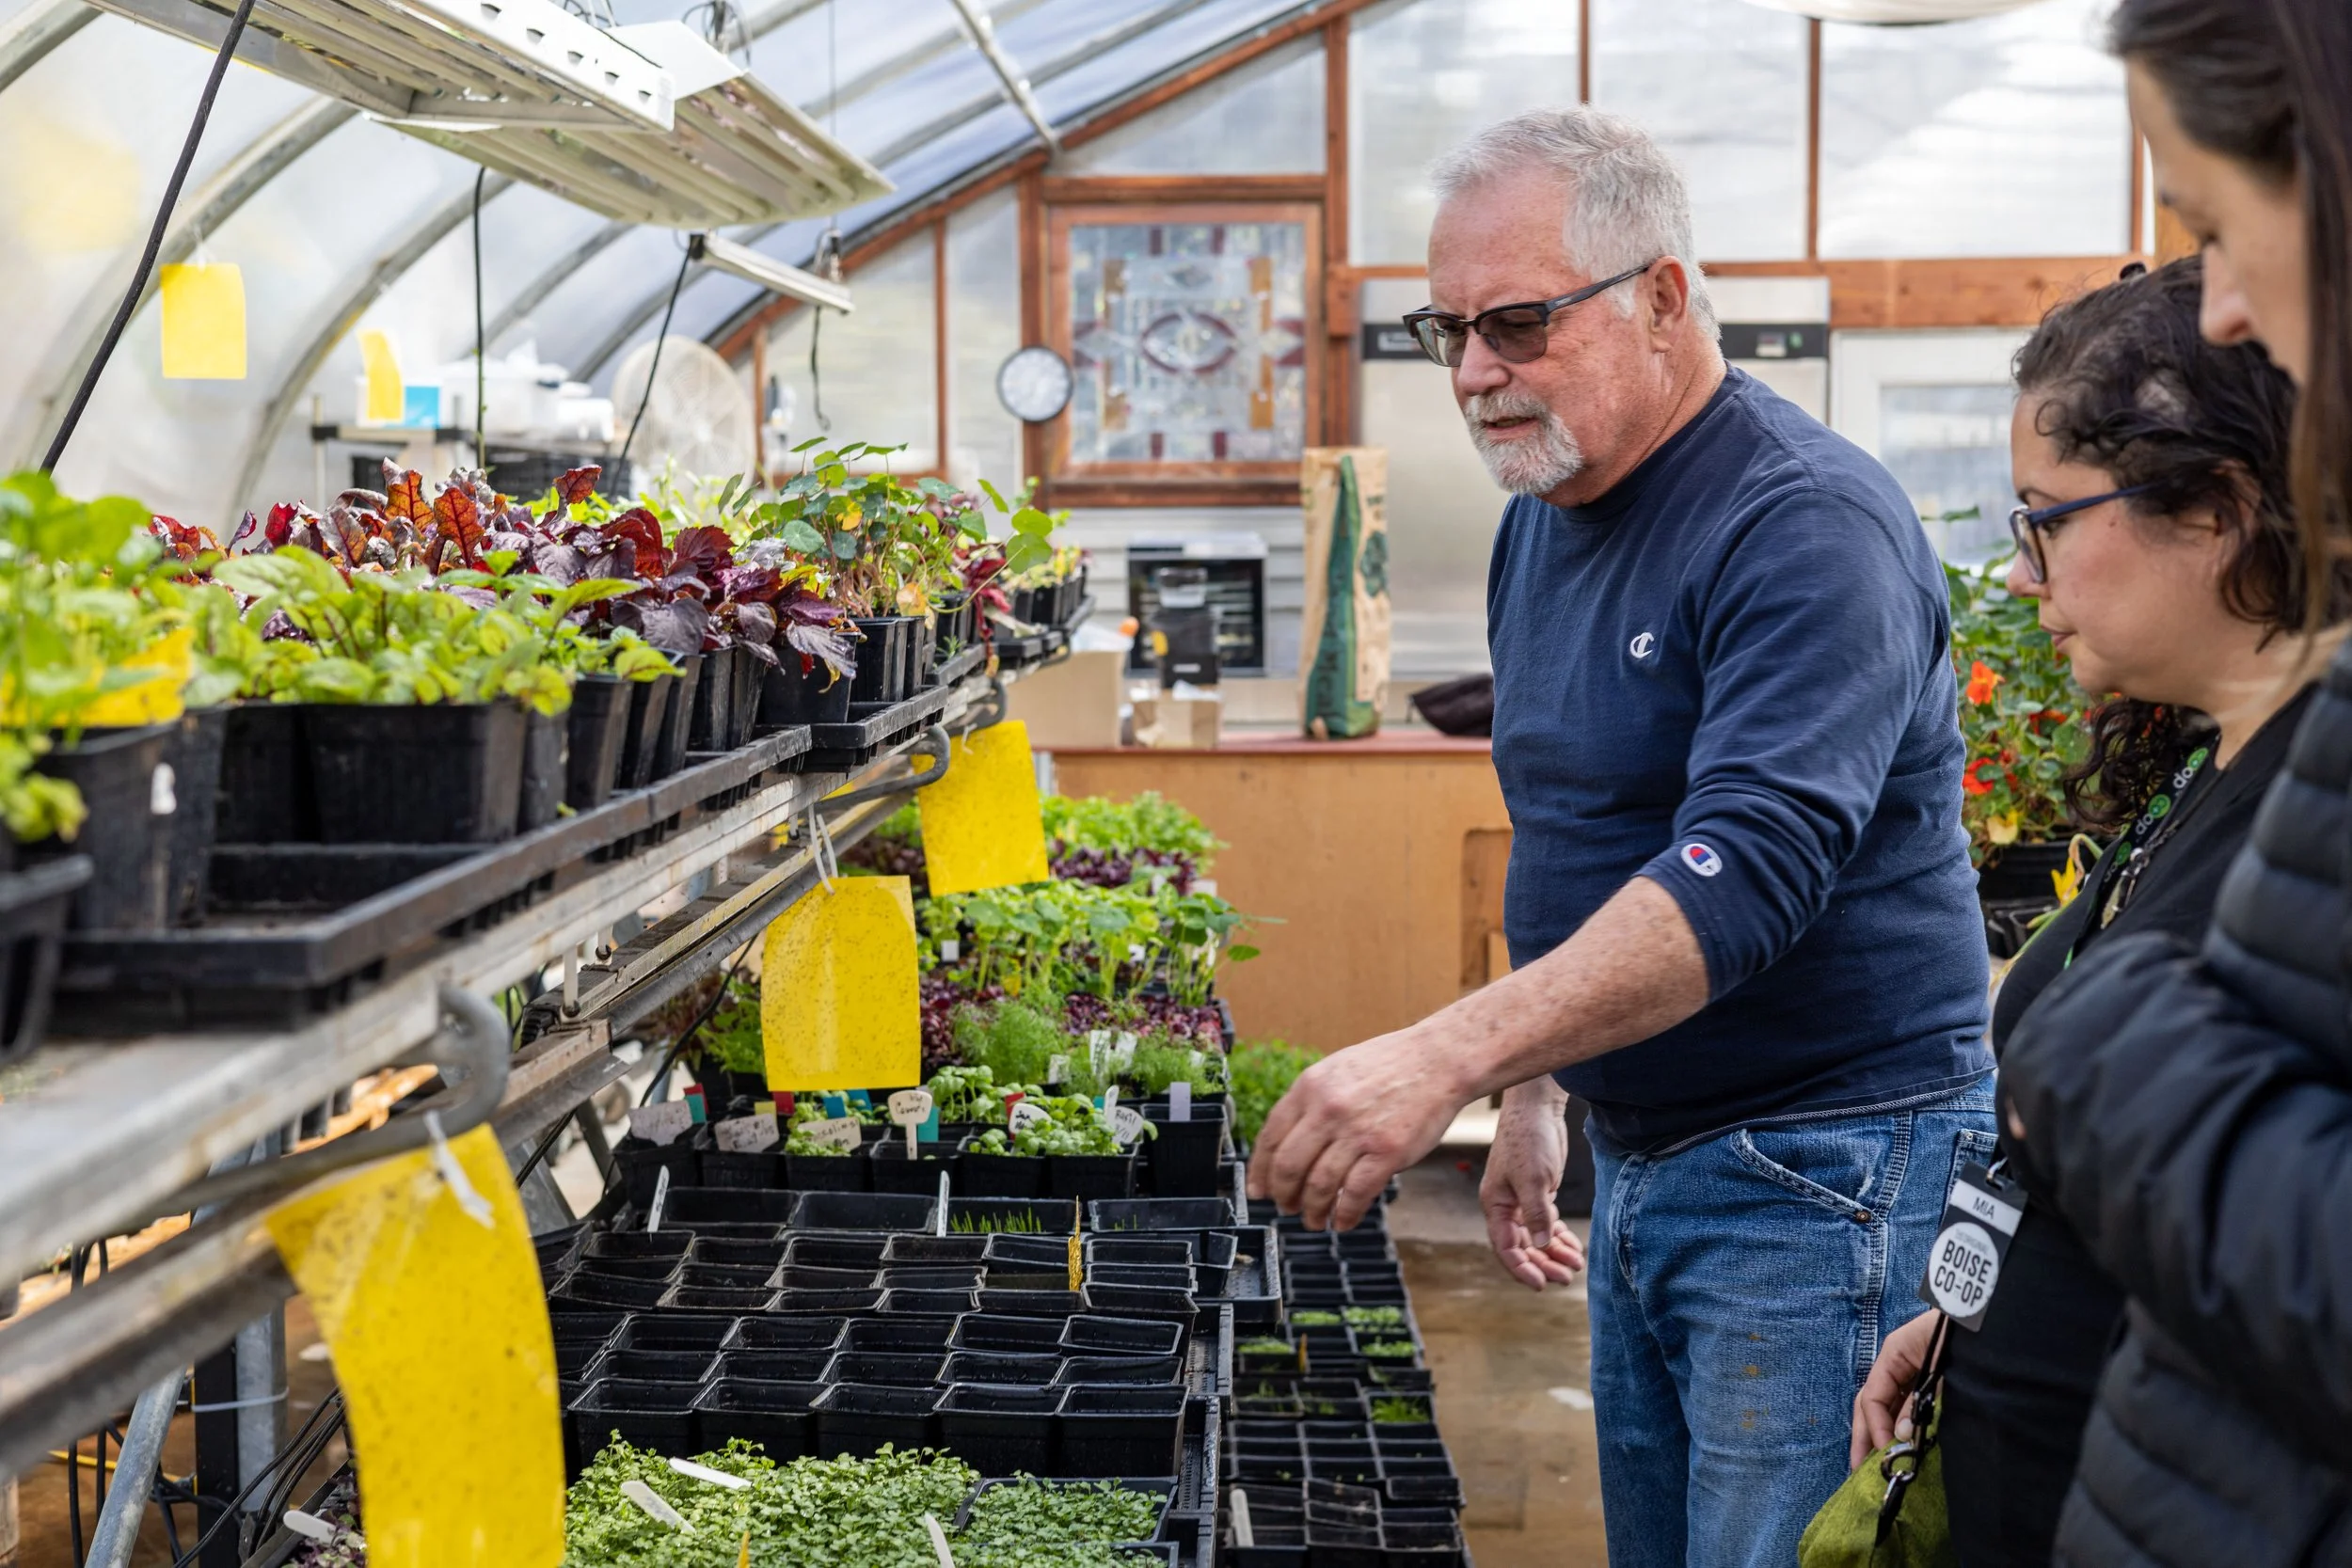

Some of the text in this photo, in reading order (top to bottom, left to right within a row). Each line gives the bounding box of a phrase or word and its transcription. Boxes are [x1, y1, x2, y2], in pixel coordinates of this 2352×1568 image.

[1973, 1197, 1994, 1219] MIA
[1943, 1240, 1992, 1284] BOISE
[1934, 1266, 1982, 1307] CO-OP
